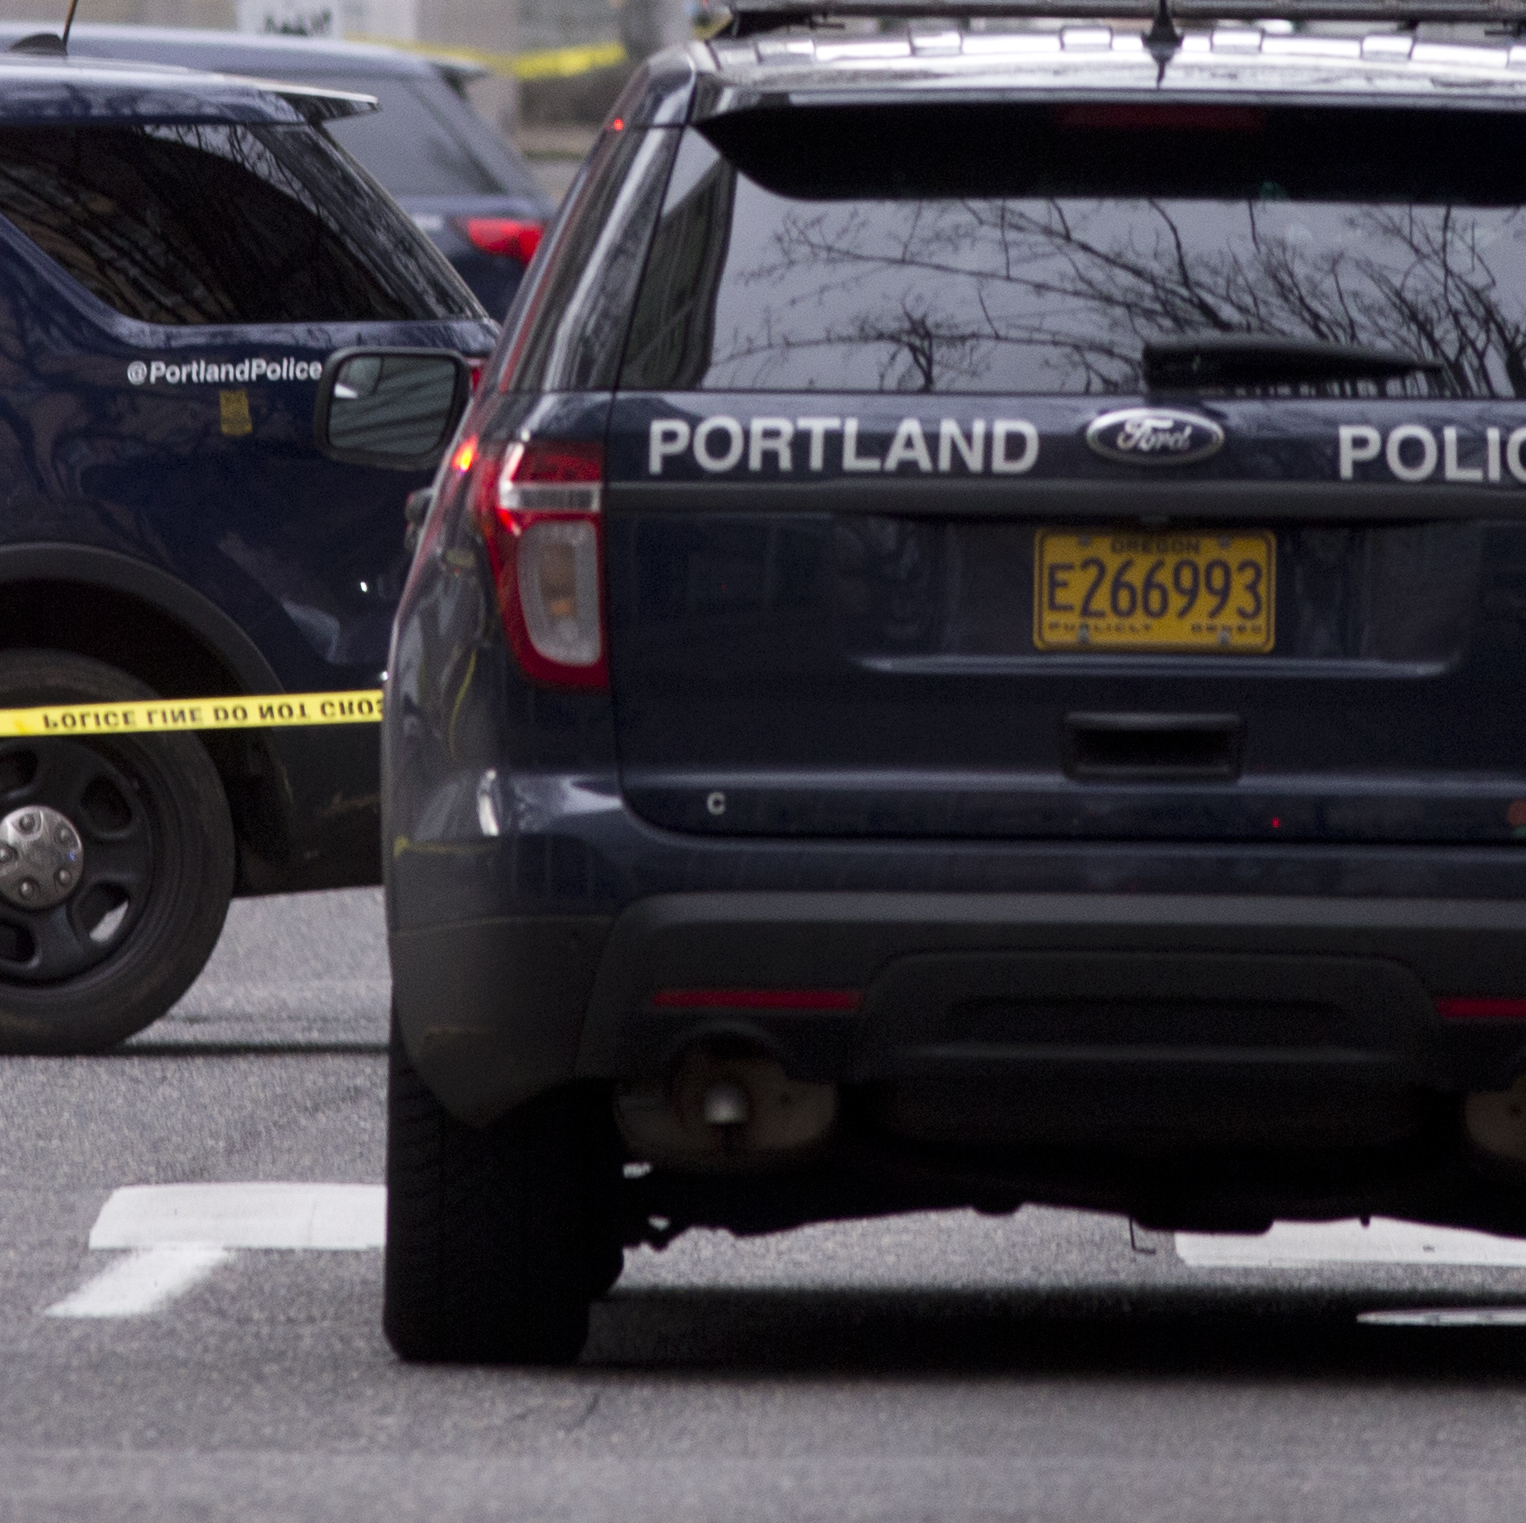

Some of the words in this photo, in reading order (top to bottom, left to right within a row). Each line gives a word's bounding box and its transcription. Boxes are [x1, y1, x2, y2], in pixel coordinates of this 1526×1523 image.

[127, 357, 322, 385] @PortlandPolice
[649, 416, 1039, 474] PORTLAND
[1116, 418, 1193, 452] Ford
[1047, 557, 1263, 620] E266993
[706, 792, 727, 816] C
